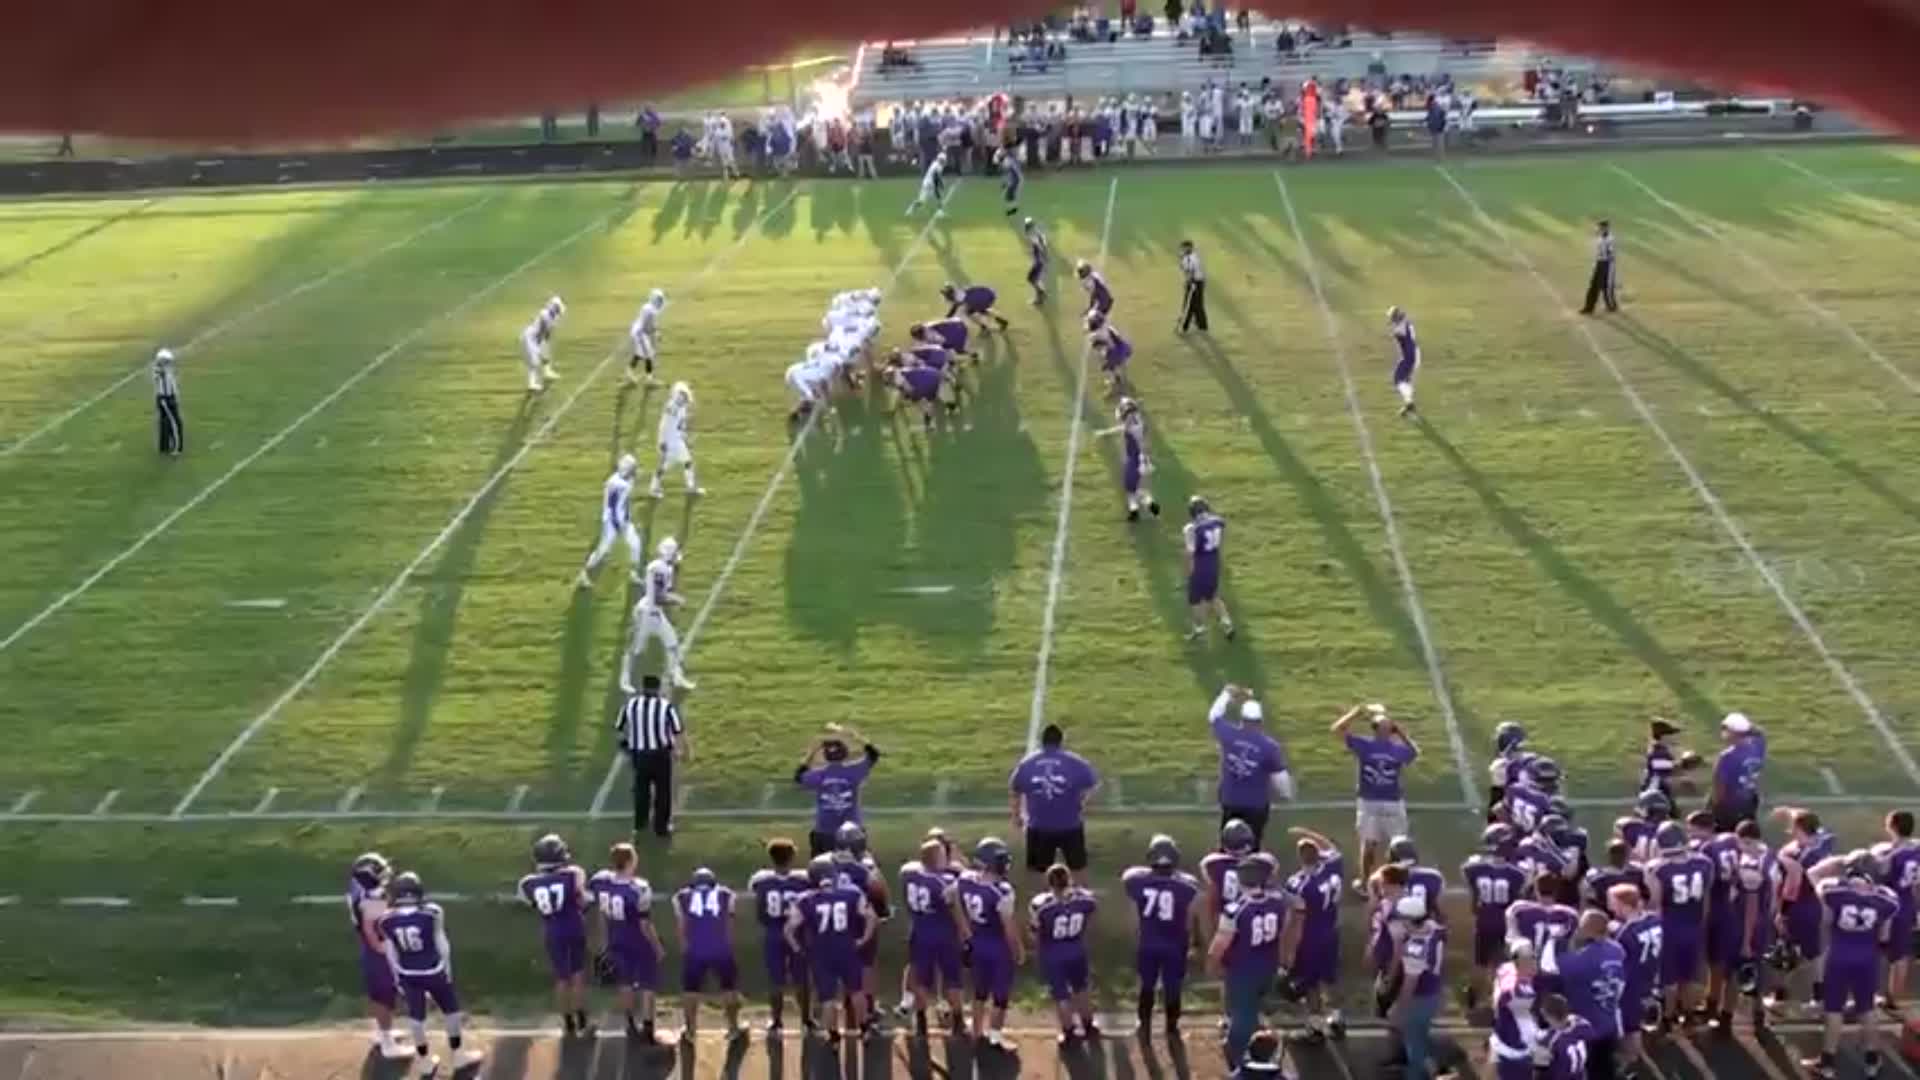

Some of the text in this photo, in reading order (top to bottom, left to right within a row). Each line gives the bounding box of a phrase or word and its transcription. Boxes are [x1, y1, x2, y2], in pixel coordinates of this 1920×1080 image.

[534, 883, 564, 915] 87
[690, 893, 720, 917] 44
[1143, 888, 1174, 921] 79
[815, 903, 848, 933] 76
[1251, 913, 1279, 947] 69
[394, 926, 424, 952] 16
